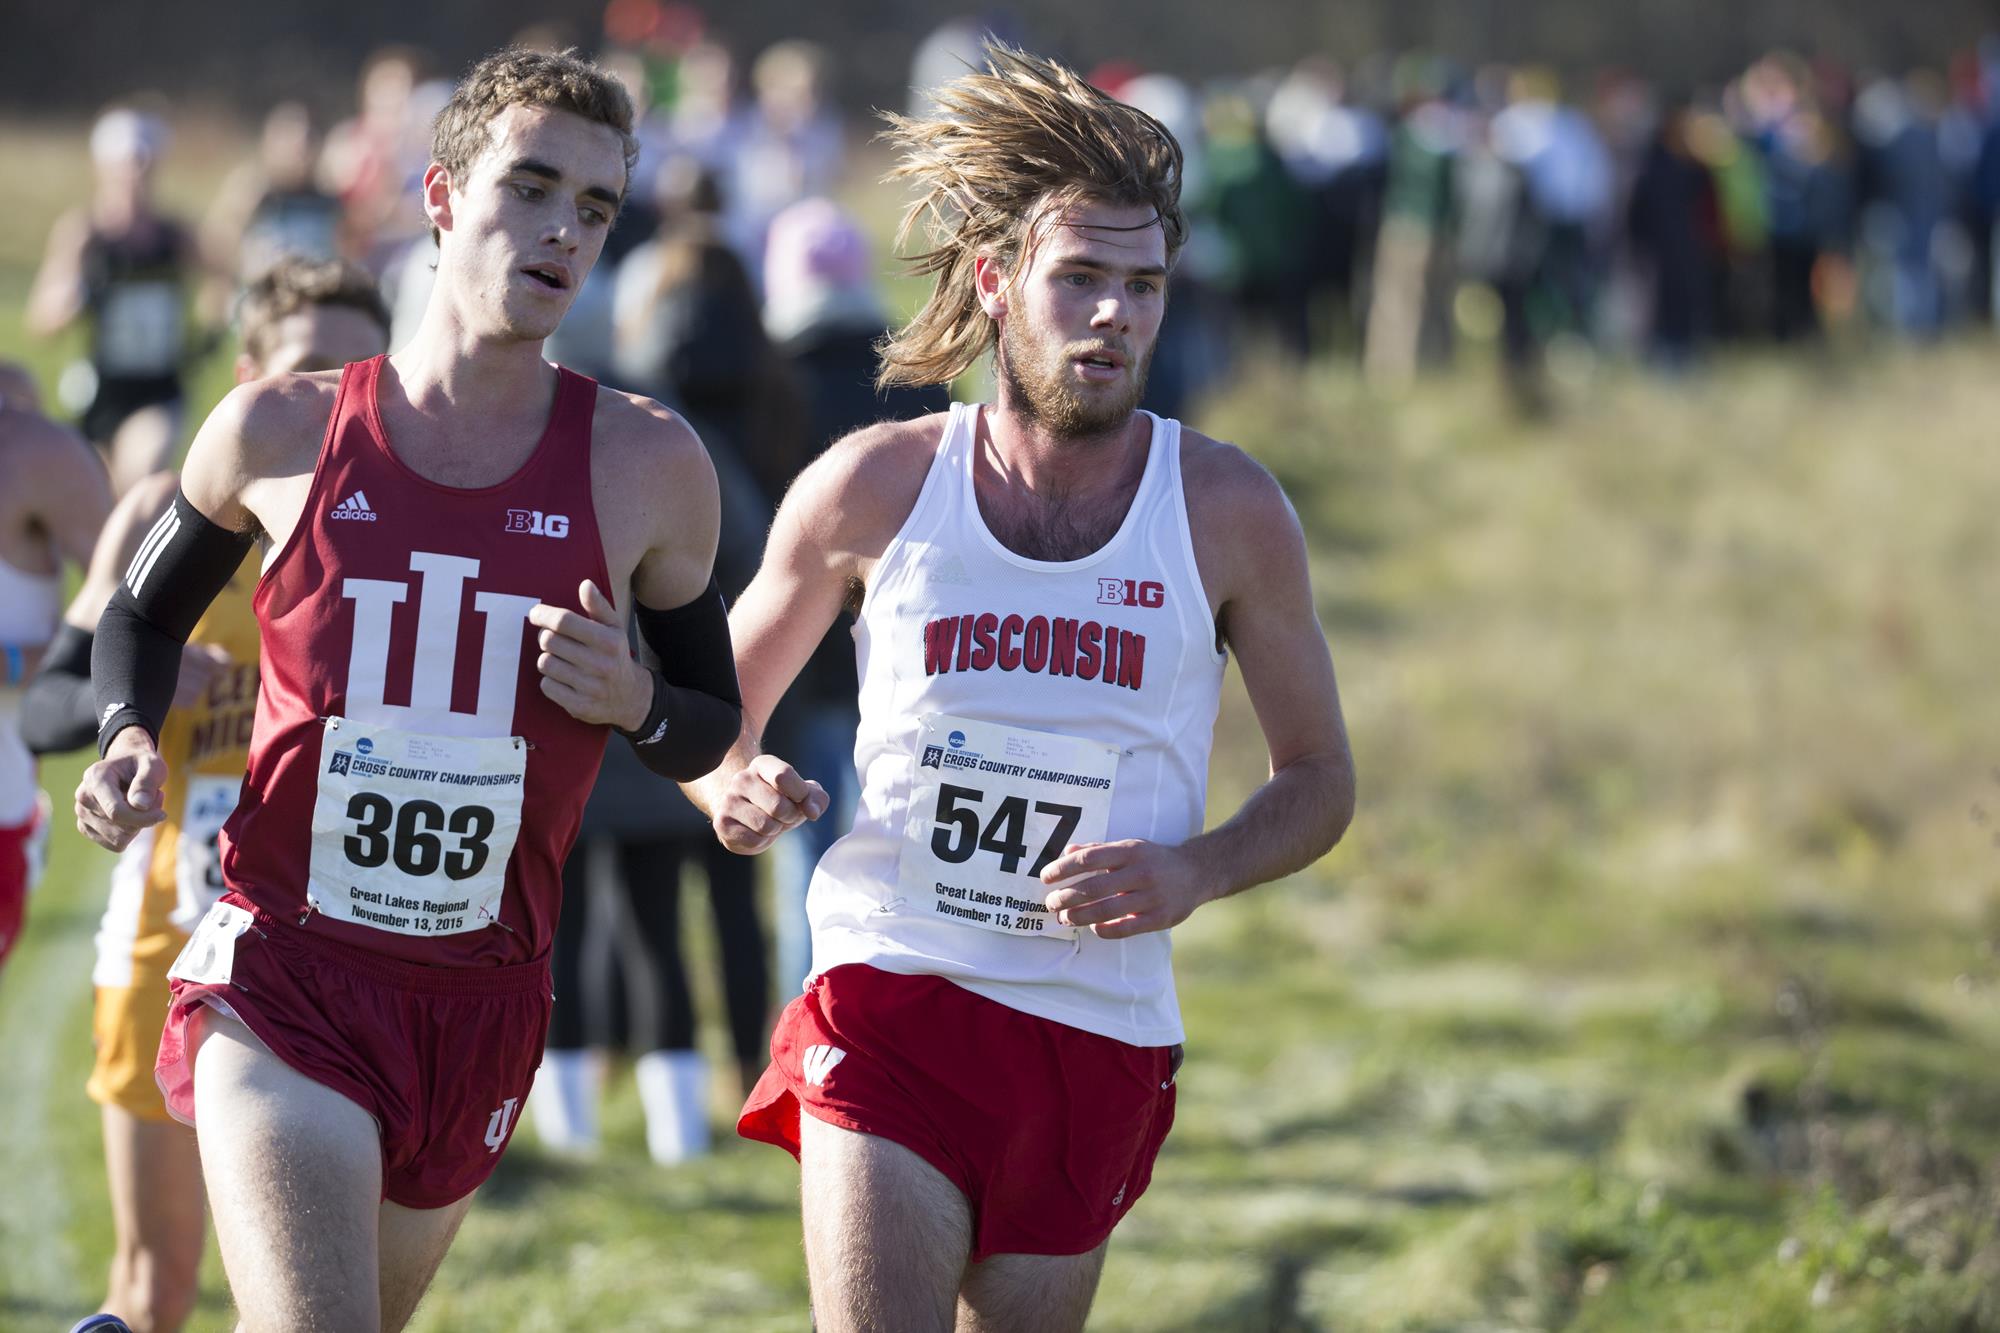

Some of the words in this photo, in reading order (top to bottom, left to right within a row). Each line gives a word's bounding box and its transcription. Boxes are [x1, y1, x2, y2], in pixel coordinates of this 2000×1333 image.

[330, 508, 377, 522] adidas
[923, 612, 1146, 691] WISCONSIN
[351, 759, 388, 776] CROSS
[388, 766, 439, 782] COUNTRY
[439, 771, 522, 787] CHAMPIONSHIPS
[943, 753, 978, 769] CROSS
[978, 759, 1027, 778] COUNTRY
[1027, 768, 1111, 790] CHAMPIONSHIPS
[344, 791, 495, 881] 363
[930, 782, 1083, 880] 547
[350, 886, 382, 904] Great
[385, 893, 420, 911] Lakes
[422, 898, 469, 915] Regional
[935, 882, 967, 900] Great
[969, 889, 1002, 906] Lakes
[1004, 896, 1049, 914] Regiona
[351, 904, 410, 929] November
[413, 917, 432, 932] 13,
[435, 917, 463, 930] 2015
[936, 900, 992, 923] November
[995, 913, 1012, 929] 13,
[1015, 917, 1043, 931] 2015
[802, 1044, 847, 1087] W
